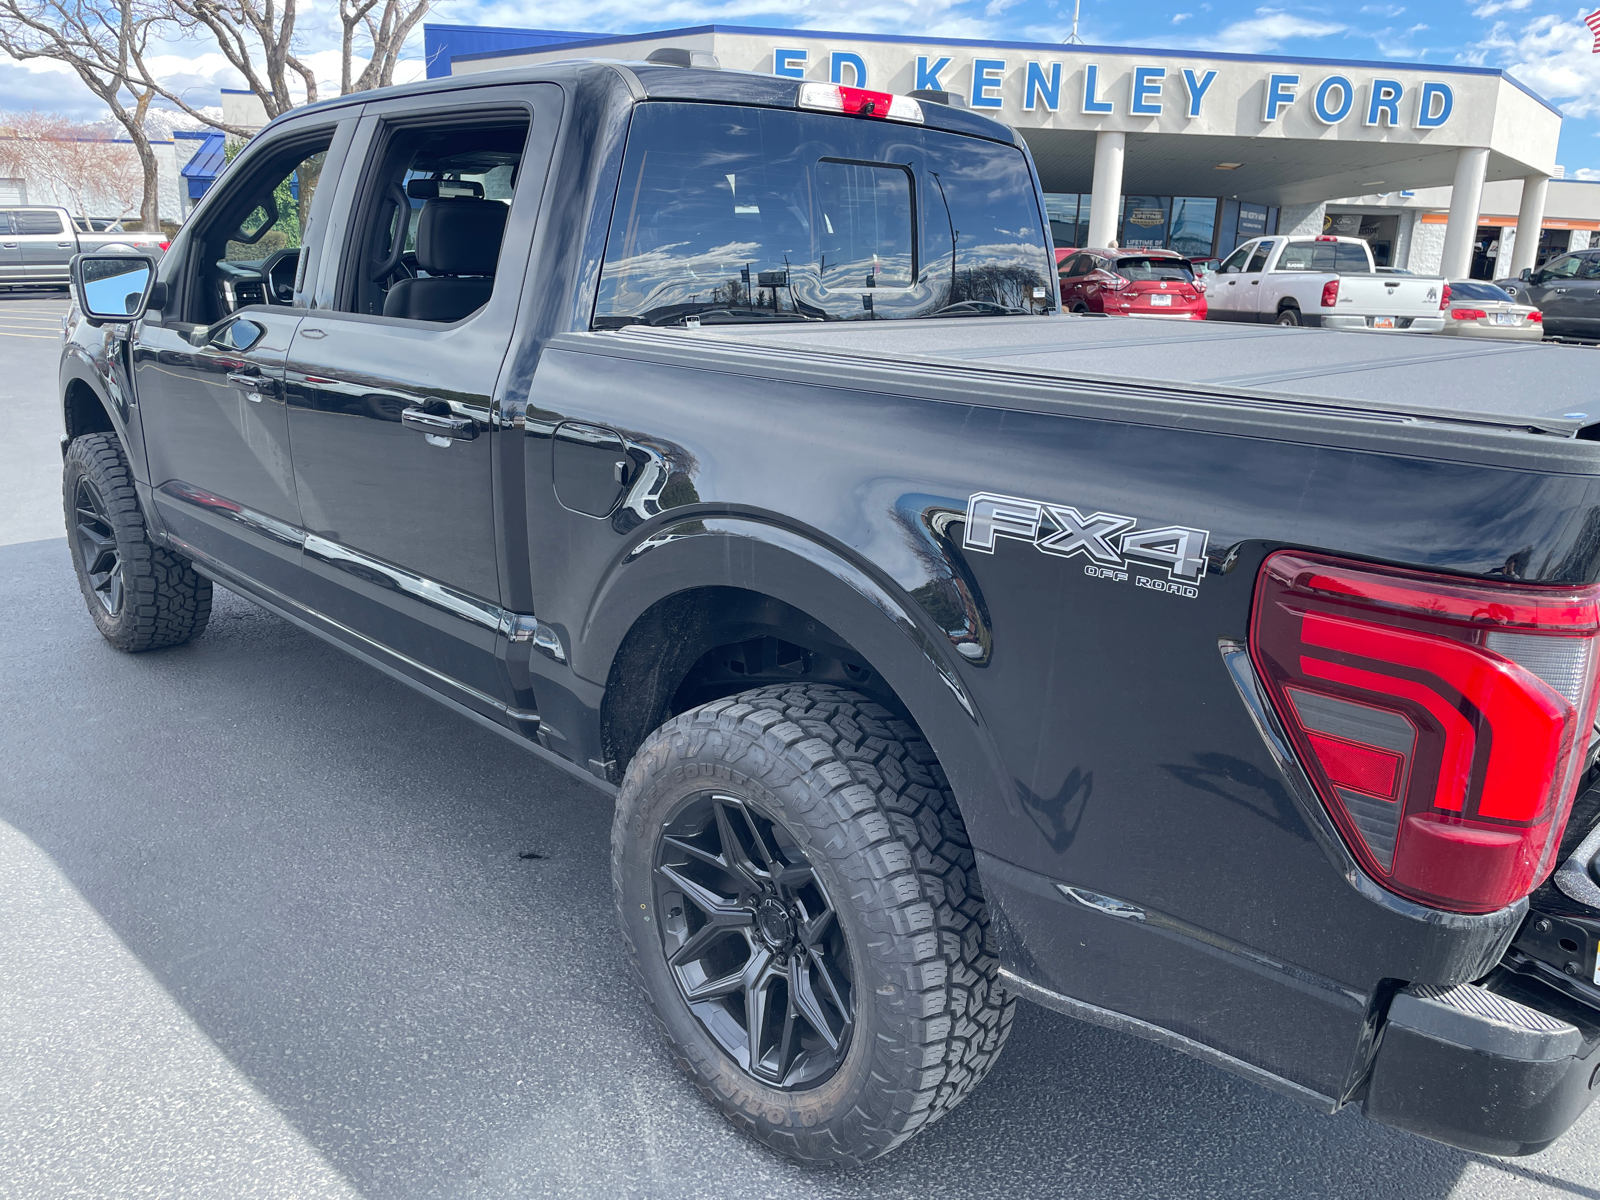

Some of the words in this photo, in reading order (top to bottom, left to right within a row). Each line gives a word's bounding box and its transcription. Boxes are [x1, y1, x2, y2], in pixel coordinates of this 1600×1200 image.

[772, 47, 868, 89] ED
[913, 55, 1220, 118] KENLEY
[1262, 73, 1454, 129] FORD
[963, 491, 1209, 585] FX4
[1084, 564, 1128, 582] OFF
[1135, 575, 1199, 599] ROAD
[672, 762, 785, 808] COUNTRY
[683, 1042, 763, 1118] TIRES
